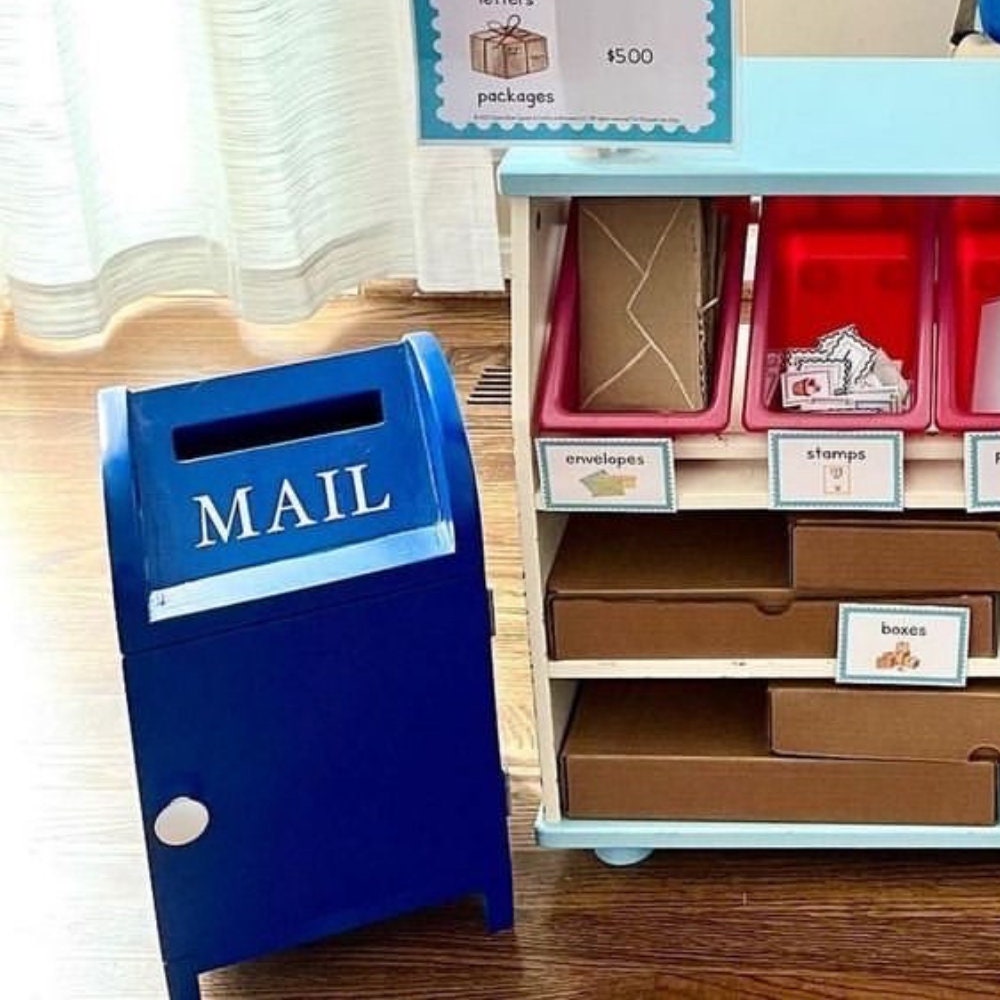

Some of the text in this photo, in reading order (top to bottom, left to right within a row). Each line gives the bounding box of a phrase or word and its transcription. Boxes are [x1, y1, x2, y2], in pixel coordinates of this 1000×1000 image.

[477, 86, 555, 109] packages
[565, 451, 645, 467] envelopes
[806, 446, 867, 464] stamps
[192, 463, 391, 548] MAIL
[880, 621, 927, 637] boxes
